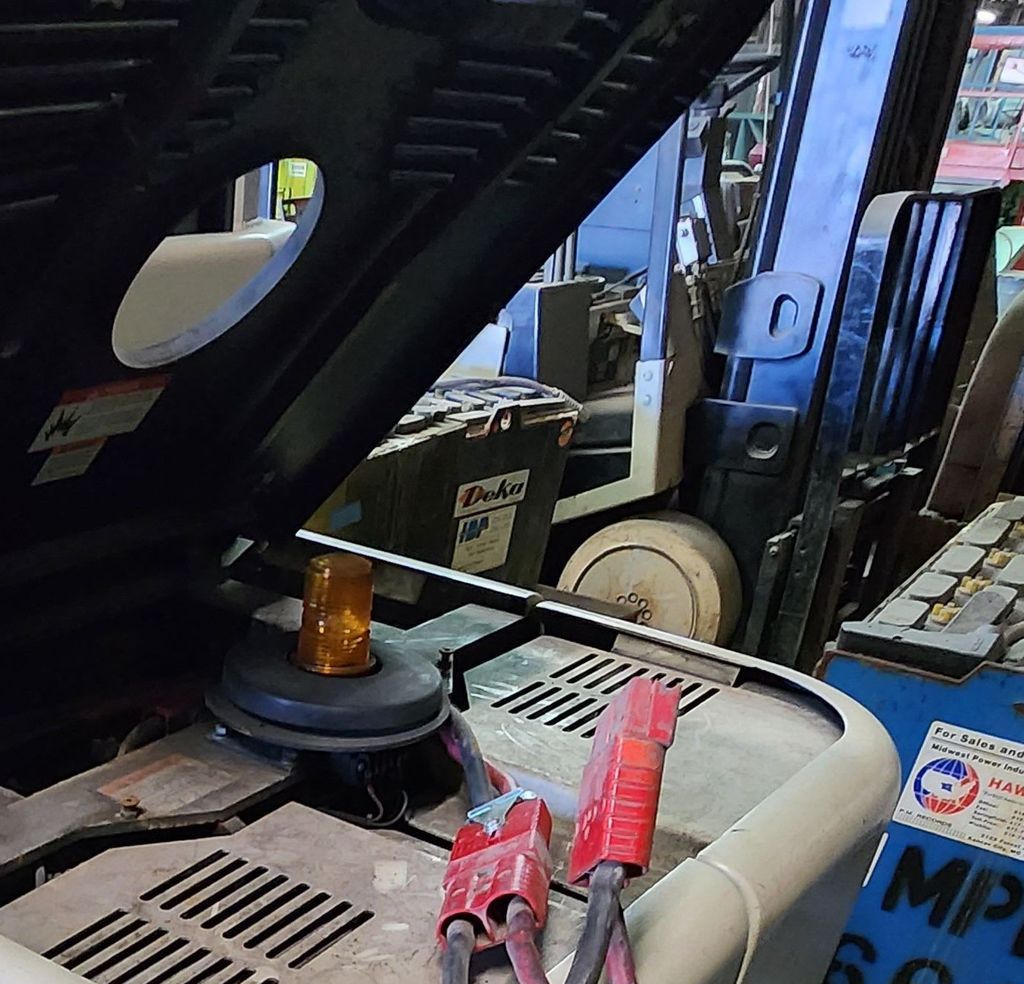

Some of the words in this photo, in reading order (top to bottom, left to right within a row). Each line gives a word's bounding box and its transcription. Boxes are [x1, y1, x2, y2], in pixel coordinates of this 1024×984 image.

[460, 478, 525, 509] Deka
[934, 726, 955, 740] For
[960, 734, 996, 751] Sales
[931, 743, 970, 760] Midwest
[972, 754, 1002, 768] Power
